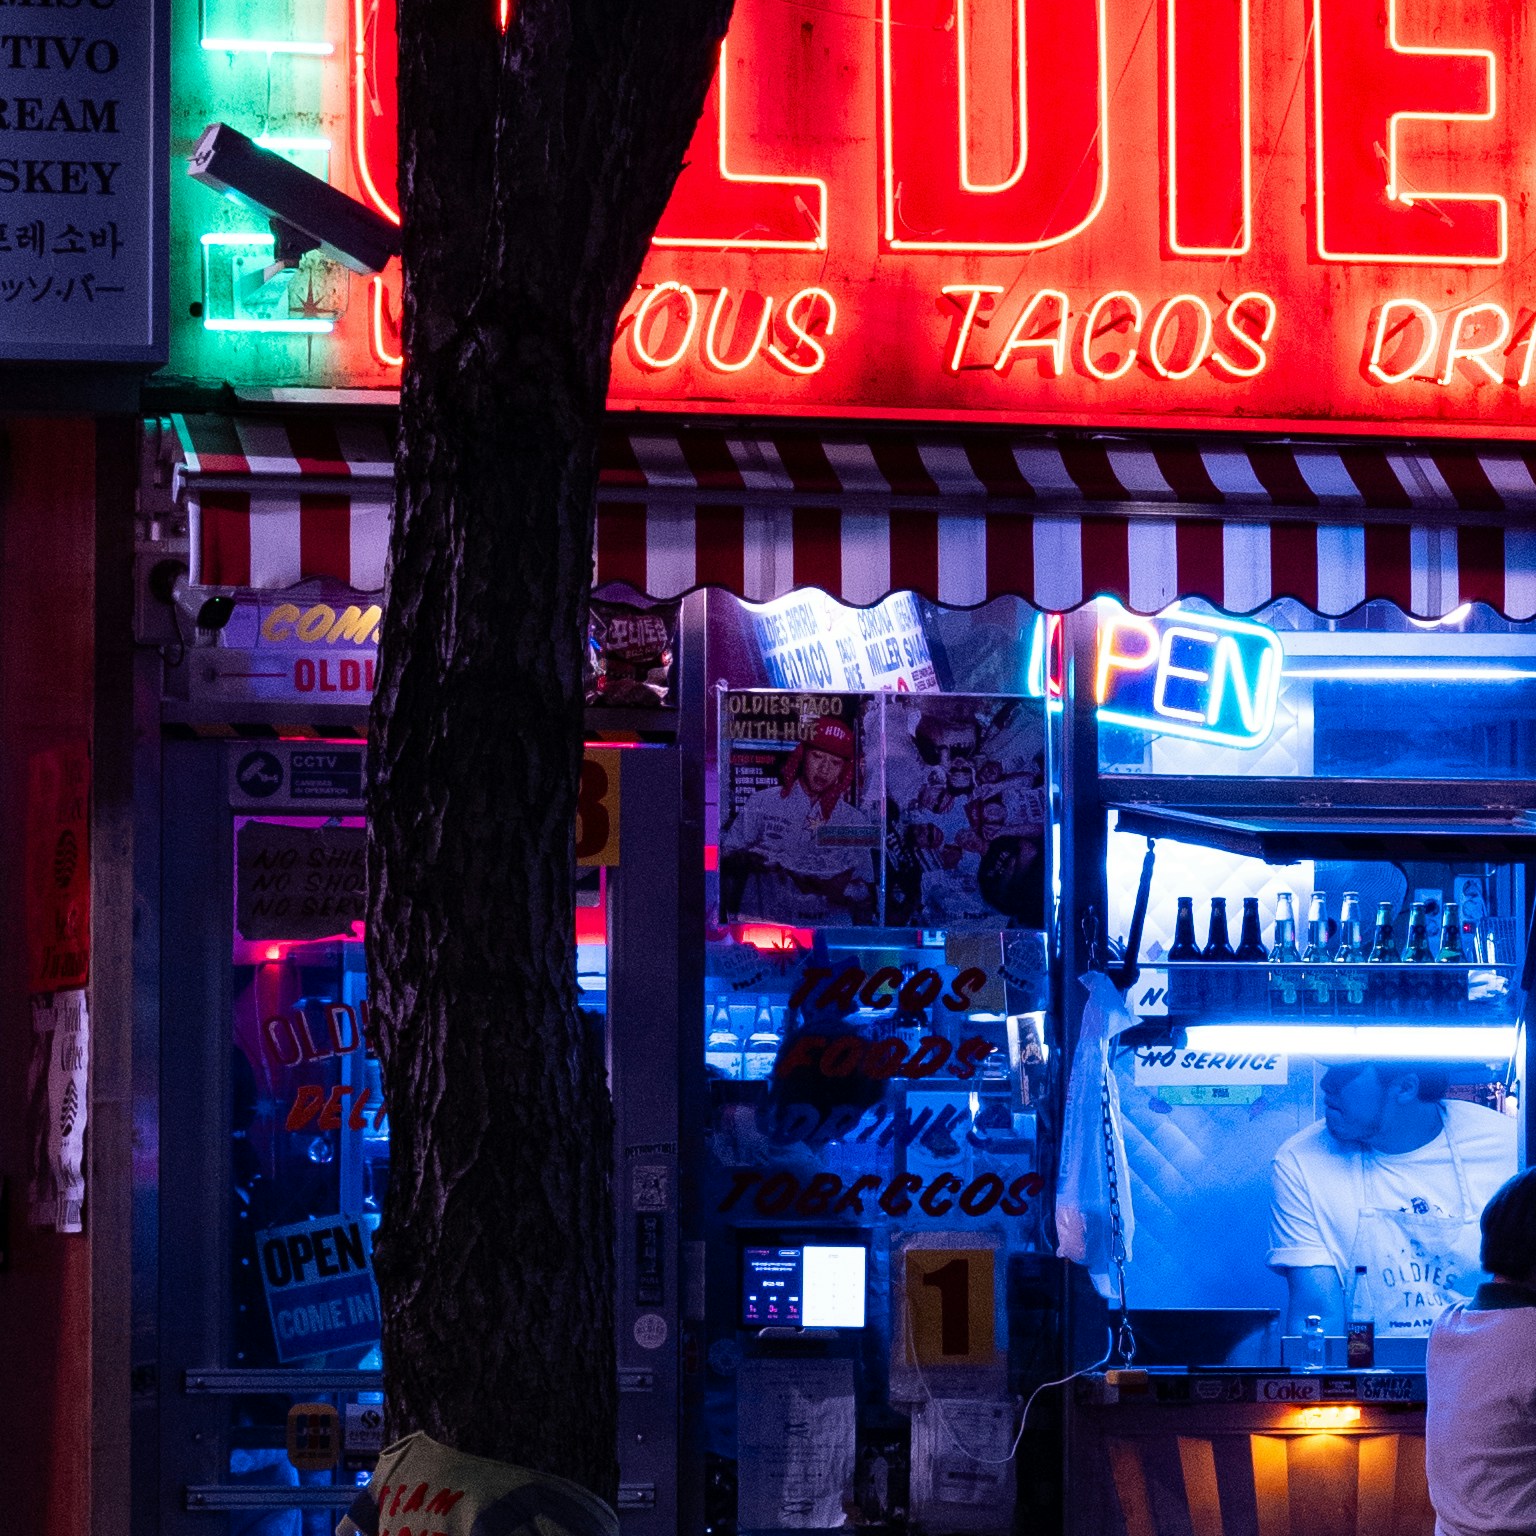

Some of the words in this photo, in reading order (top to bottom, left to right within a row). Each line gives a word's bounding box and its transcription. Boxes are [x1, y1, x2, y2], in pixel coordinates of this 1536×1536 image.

[942, 284, 1277, 381] TACOS
[292, 755, 338, 769] CCTV
[252, 848, 298, 870] NO
[251, 872, 291, 892] NO
[251, 897, 290, 917] NO
[788, 966, 987, 1012] TACOS
[775, 1034, 995, 1080] FOODS
[1141, 1051, 1177, 1068] NO
[1181, 1051, 1281, 1070] SERVICE
[262, 1222, 368, 1289] OPEN
[1382, 1261, 1458, 1291] OLDIES
[276, 1304, 341, 1342] COME
[343, 1292, 375, 1322] IN
[922, 1258, 969, 1356] 1
[1263, 1380, 1314, 1402] Coke
